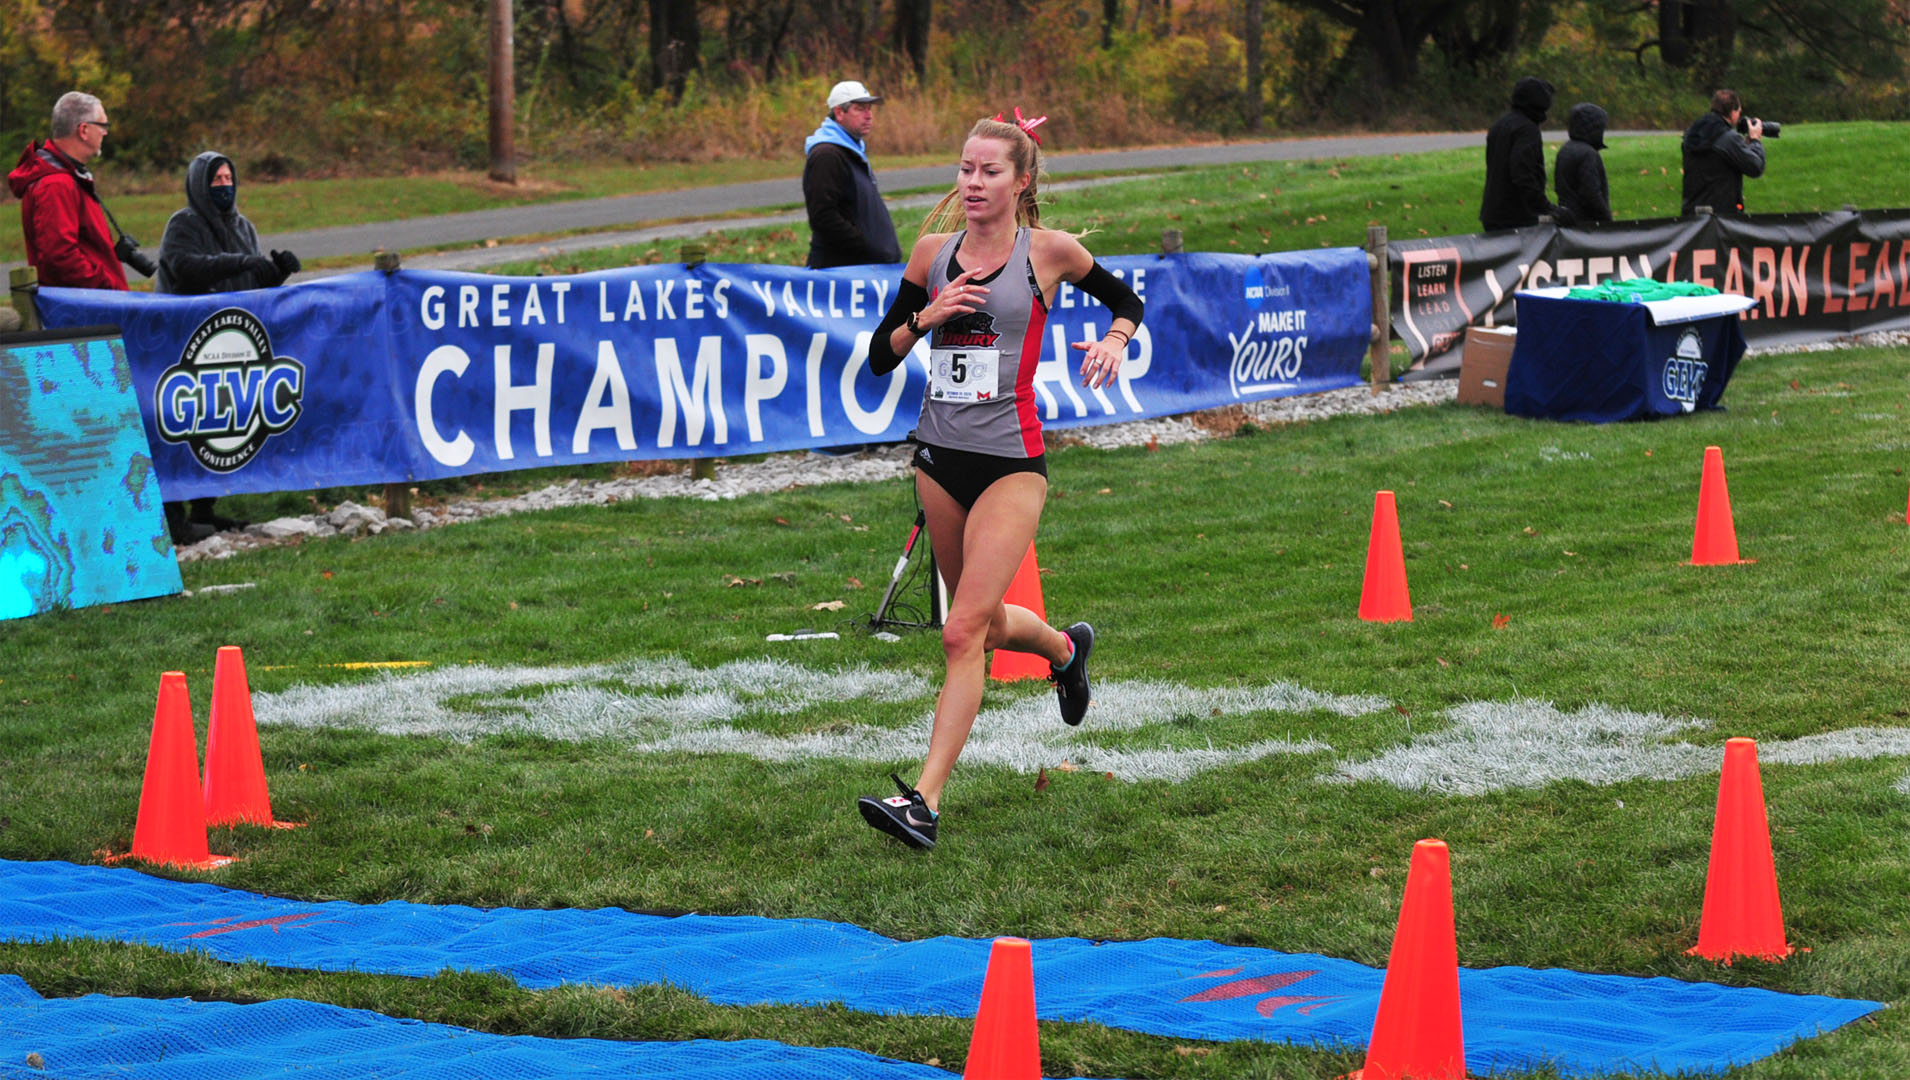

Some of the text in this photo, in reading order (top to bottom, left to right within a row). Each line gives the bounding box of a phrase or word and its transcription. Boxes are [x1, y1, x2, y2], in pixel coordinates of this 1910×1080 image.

[1418, 264, 1447, 278] LISTEN
[1417, 283, 1446, 297] LEARN
[421, 282, 571, 330] GREAT
[599, 278, 732, 322] LAKES
[752, 279, 889, 318] VALLEY
[1418, 301, 1450, 315] LEAD
[1258, 309, 1307, 333] MAKE IT
[186, 314, 268, 360] GREAT LAKES VALLEY
[941, 332, 998, 347] DRURY
[951, 353, 967, 384] 5
[158, 363, 300, 437] GLVC
[415, 322, 1153, 467] CHAMPIOHIP
[198, 445, 256, 467] CONFERENCE
